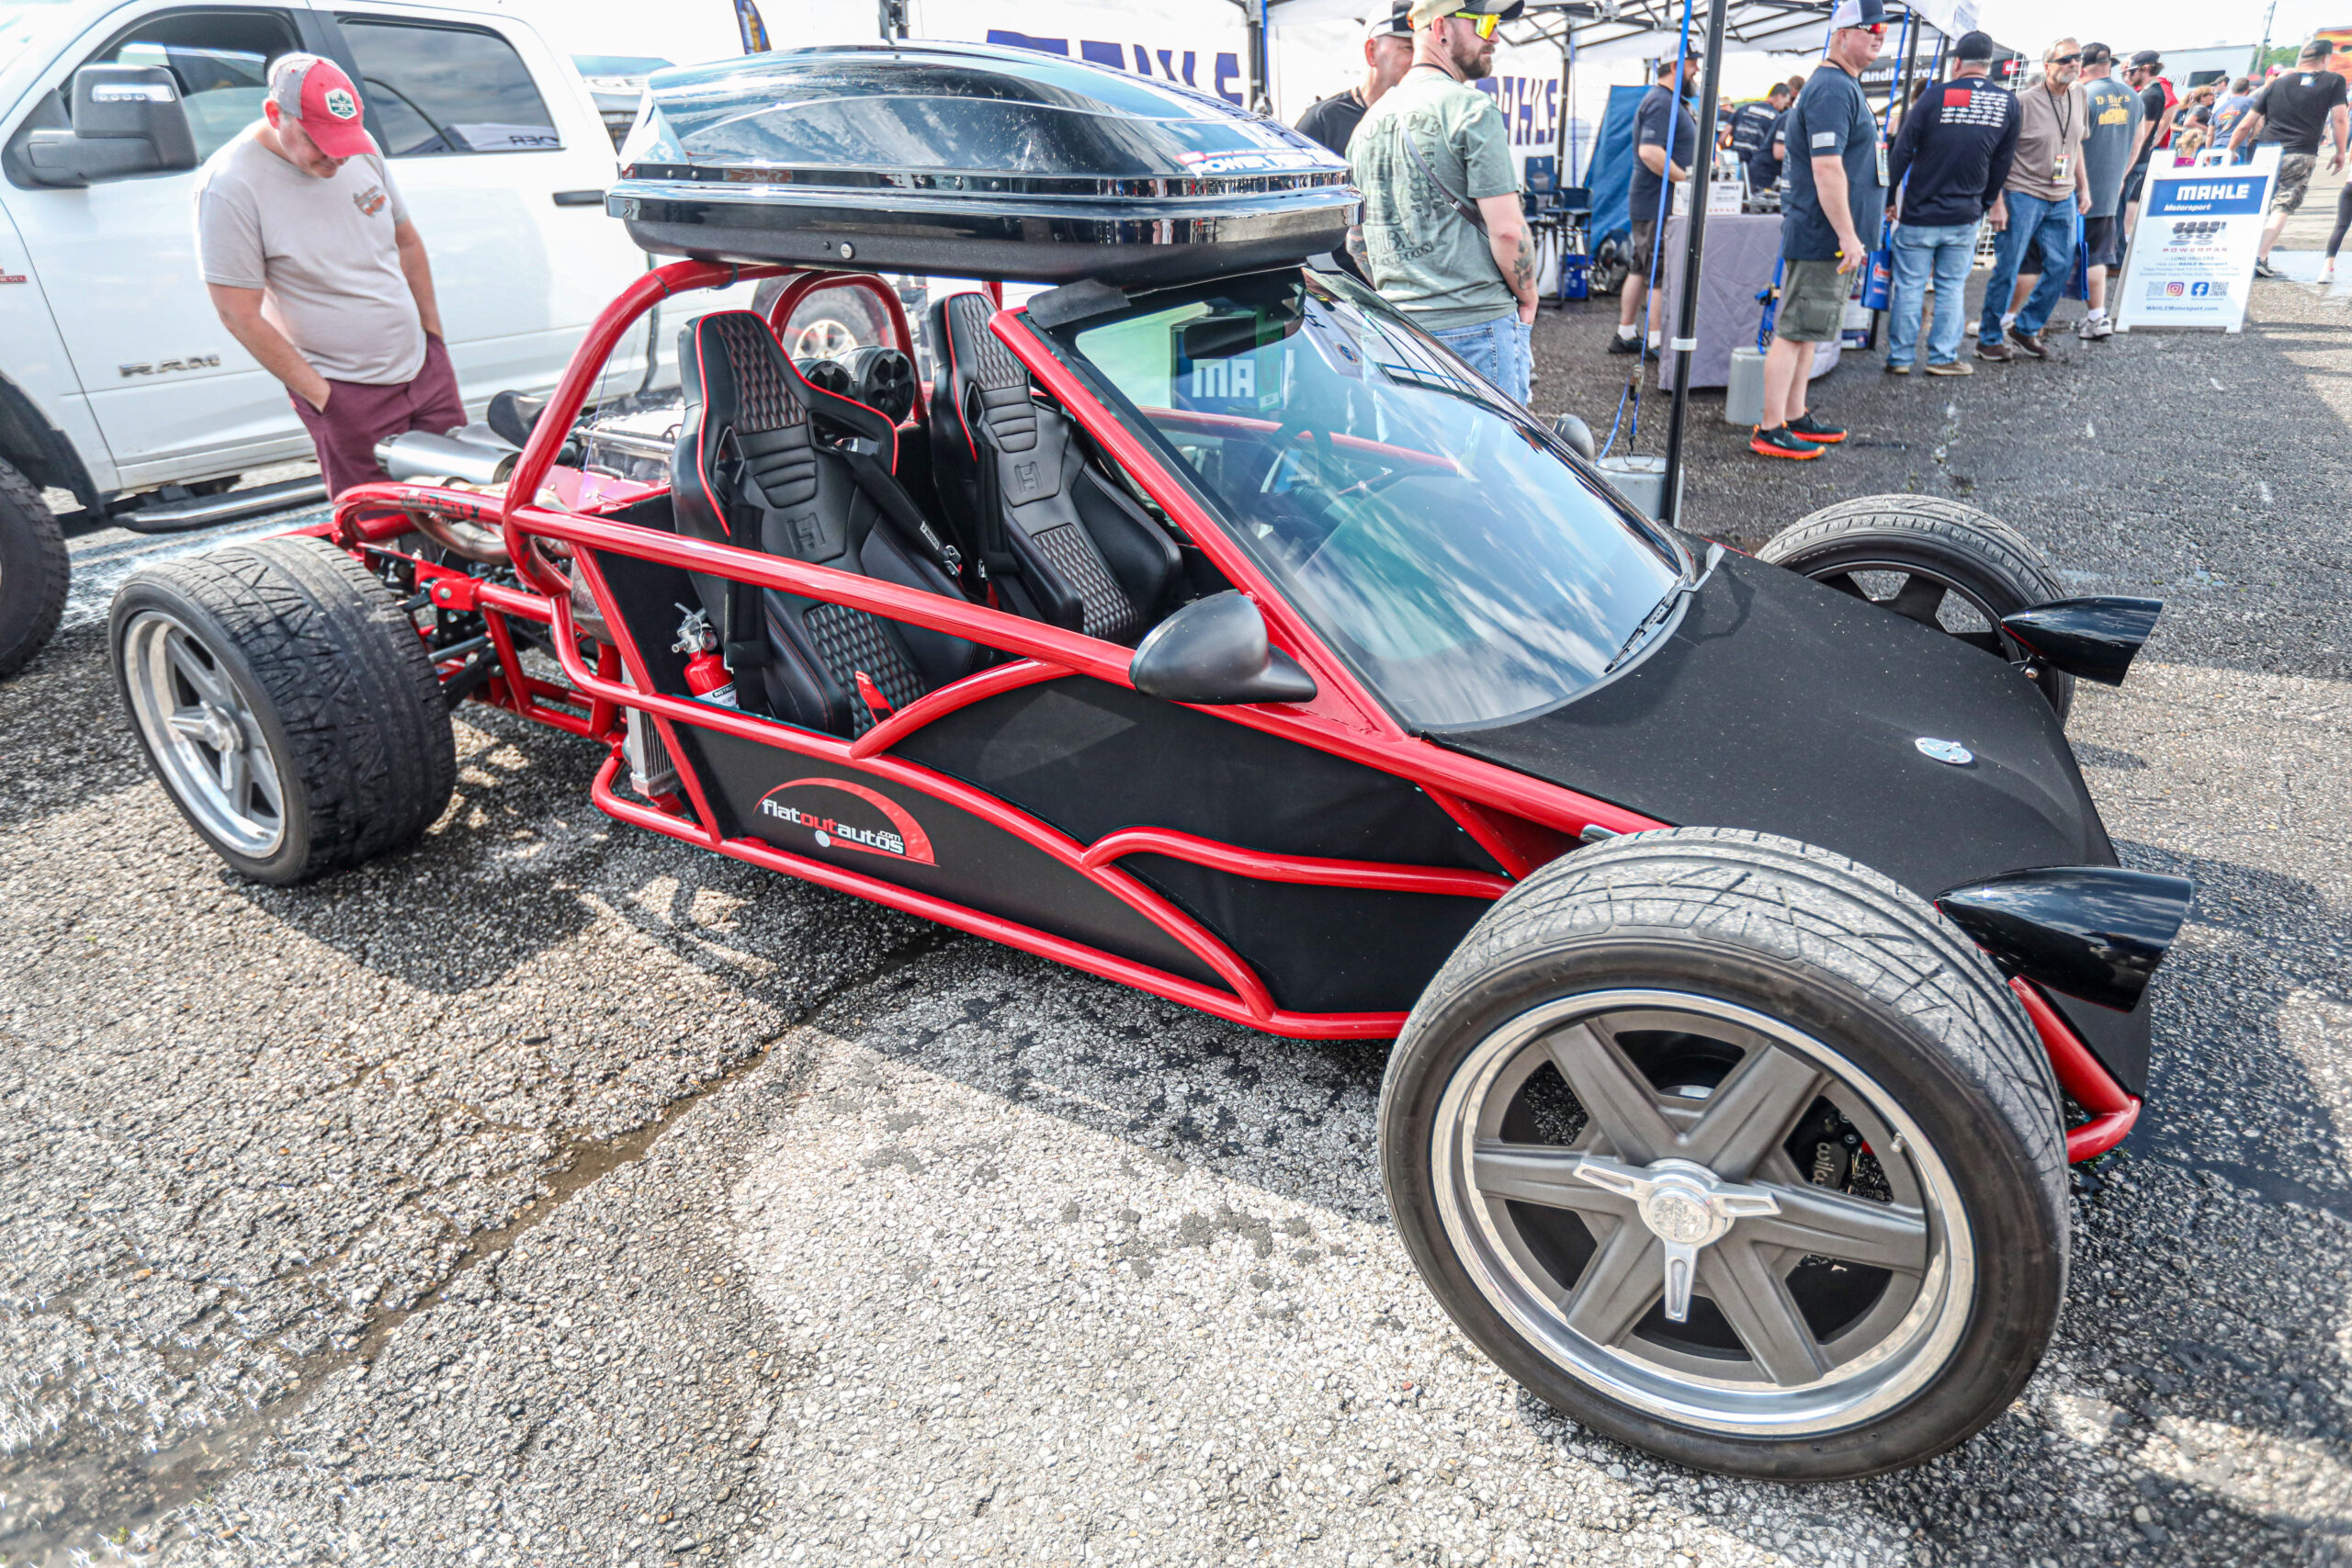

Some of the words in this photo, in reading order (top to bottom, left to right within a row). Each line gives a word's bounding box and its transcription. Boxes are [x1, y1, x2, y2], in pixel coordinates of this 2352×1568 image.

[2176, 183, 2251, 201] MAHLE
[2163, 203, 2211, 212] Motorsport
[119, 354, 221, 378] RAM
[762, 798, 905, 855] flatoutautos
